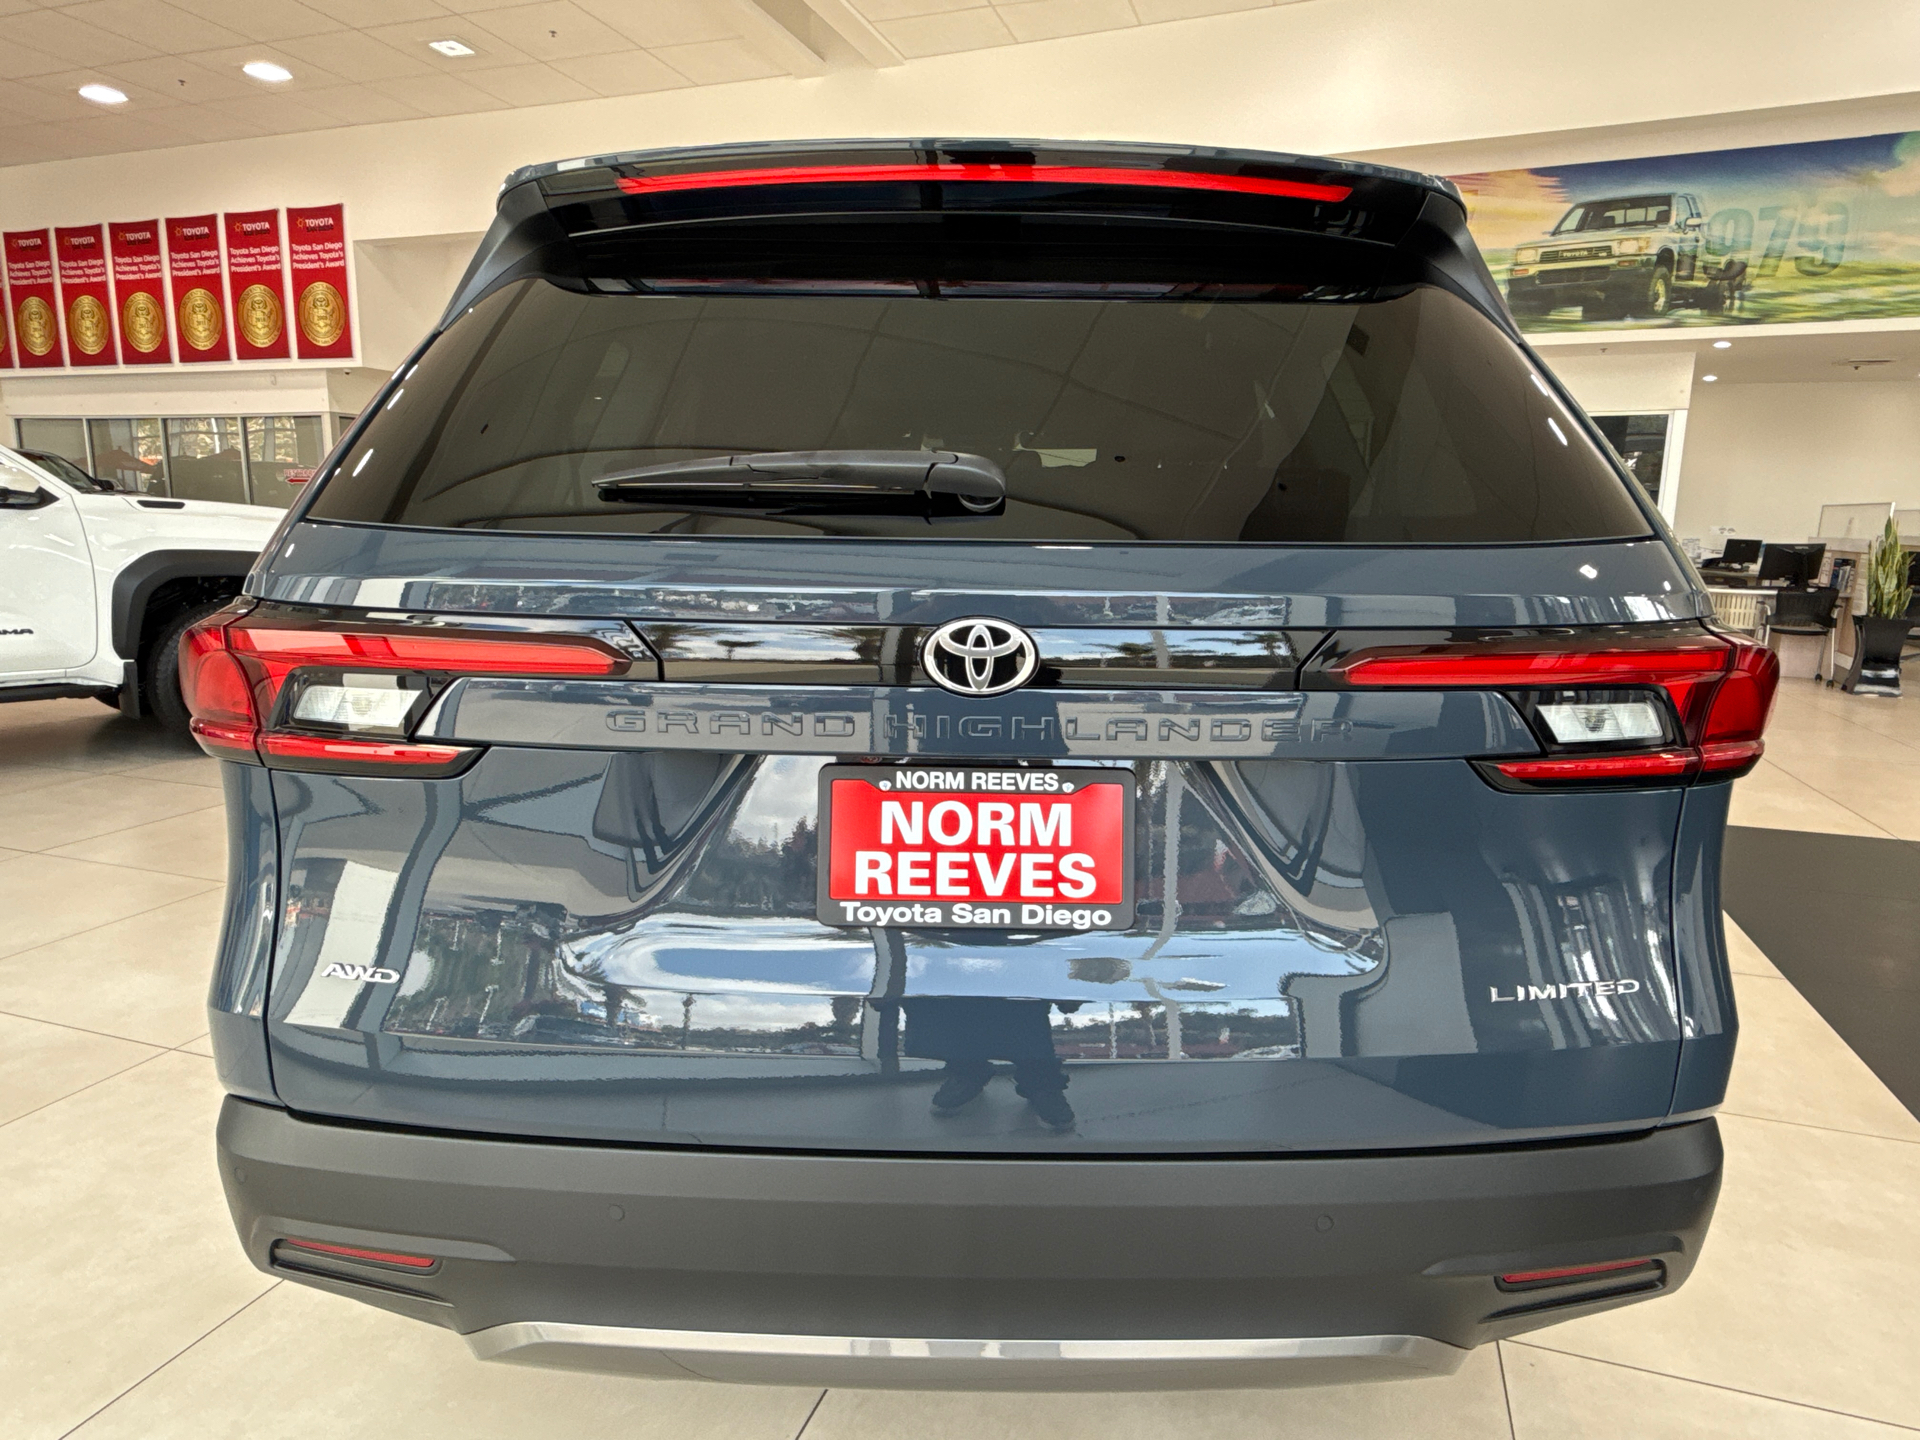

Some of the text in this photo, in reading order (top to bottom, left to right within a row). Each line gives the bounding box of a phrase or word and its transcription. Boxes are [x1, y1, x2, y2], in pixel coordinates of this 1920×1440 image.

[242, 221, 270, 231] TOYOTA
[305, 217, 334, 227] TOYOTA
[125, 231, 151, 240] TOYOTA
[183, 226, 210, 236] TOYOTA
[229, 245, 279, 255] Toyota San Diego
[292, 241, 343, 252] Toyota San Diego
[319, 250, 344, 260] Toyota's
[263, 262, 280, 271] Award
[293, 258, 345, 269] President's Award
[283, 468, 317, 478] RESTROO
[605, 709, 1350, 742] GRAND HIGHLANDER
[895, 771, 1059, 792] NORM REEVES
[880, 800, 1072, 847] NORM
[854, 850, 1097, 899] REEVES
[839, 901, 1112, 930] Toyota San Diego
[320, 962, 400, 985] AWD
[1489, 978, 1640, 1003] LIMITED
